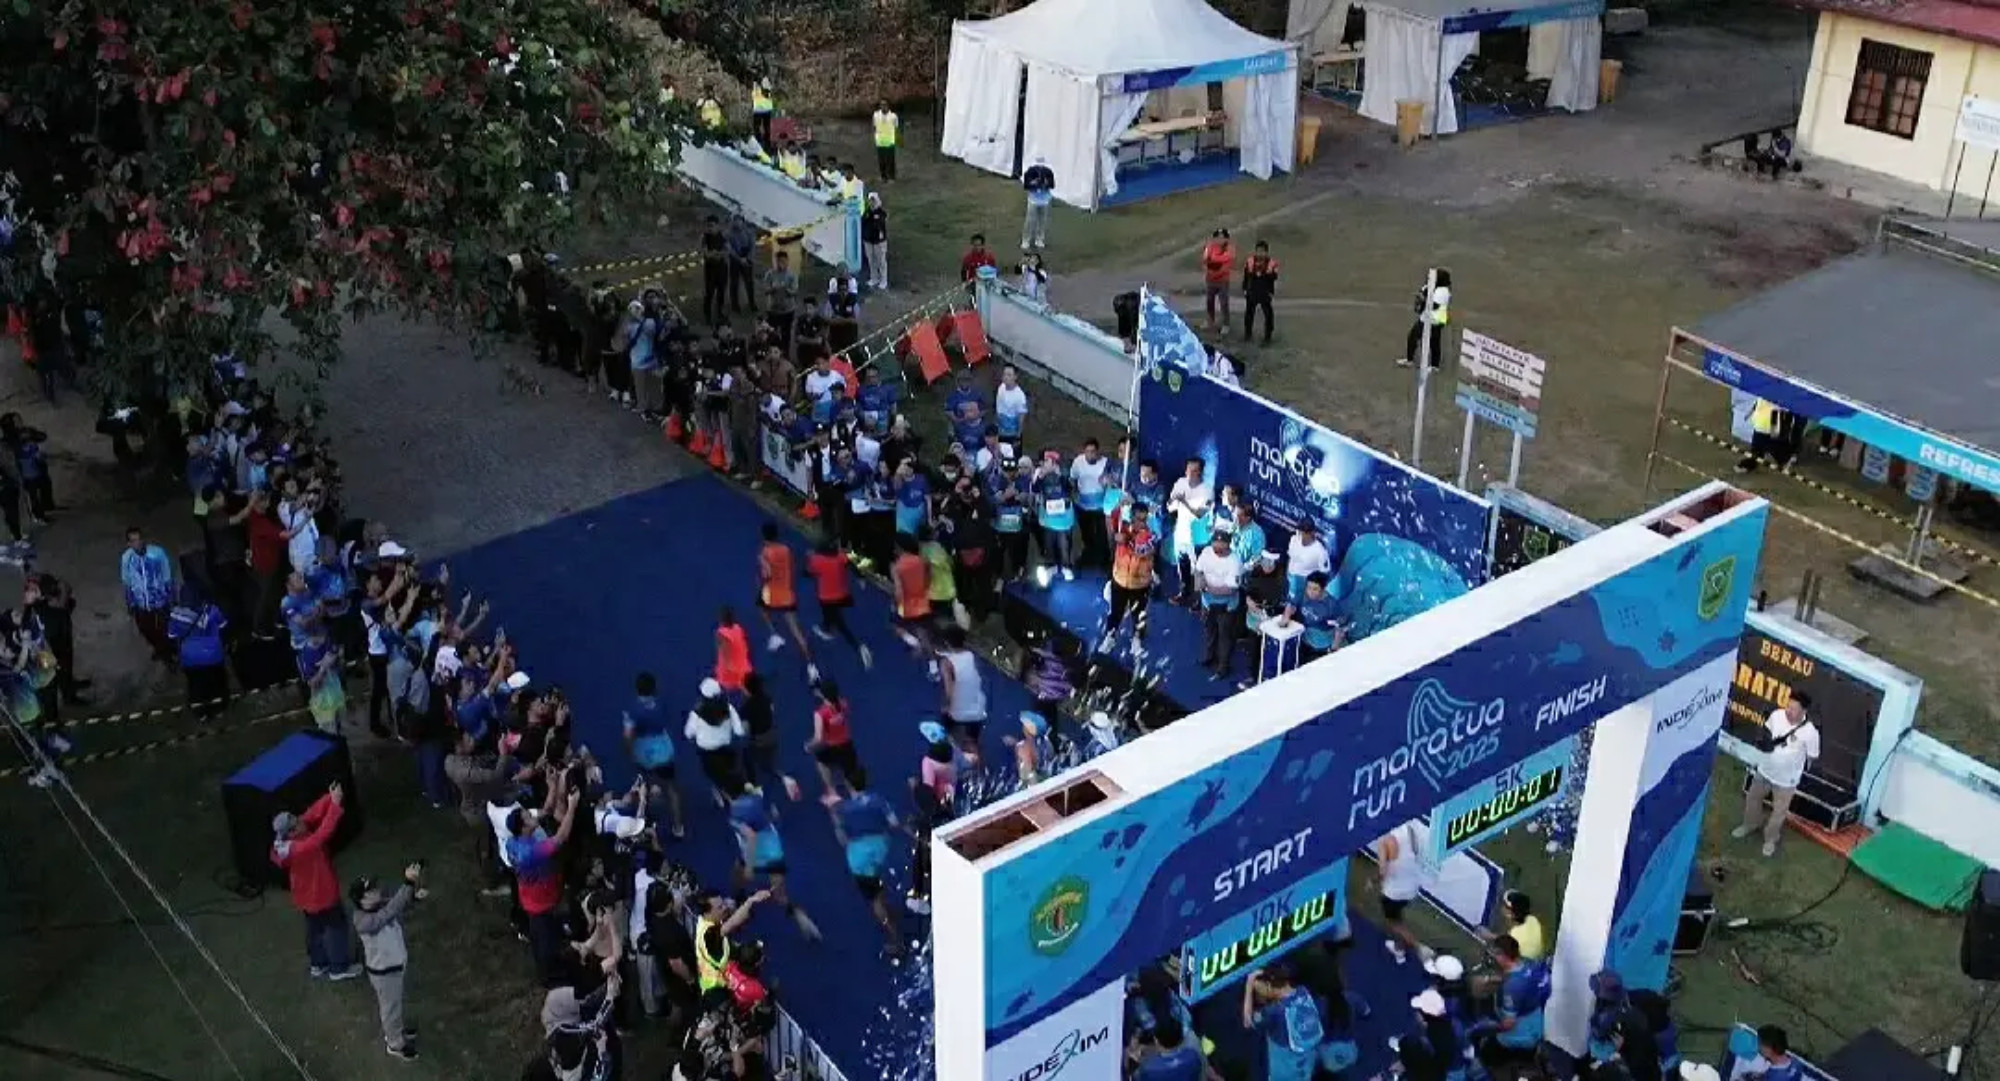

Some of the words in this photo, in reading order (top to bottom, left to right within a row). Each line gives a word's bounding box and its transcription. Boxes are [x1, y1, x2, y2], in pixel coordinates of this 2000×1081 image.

[1248, 456, 1281, 487] run
[1760, 639, 1815, 677] BERAU
[1534, 674, 1607, 732] FINISH
[1732, 661, 1792, 710] RATU
[1352, 697, 1505, 797] maratua
[1443, 727, 1501, 779] 2025
[1347, 779, 1407, 832] run
[1213, 826, 1312, 902] START
